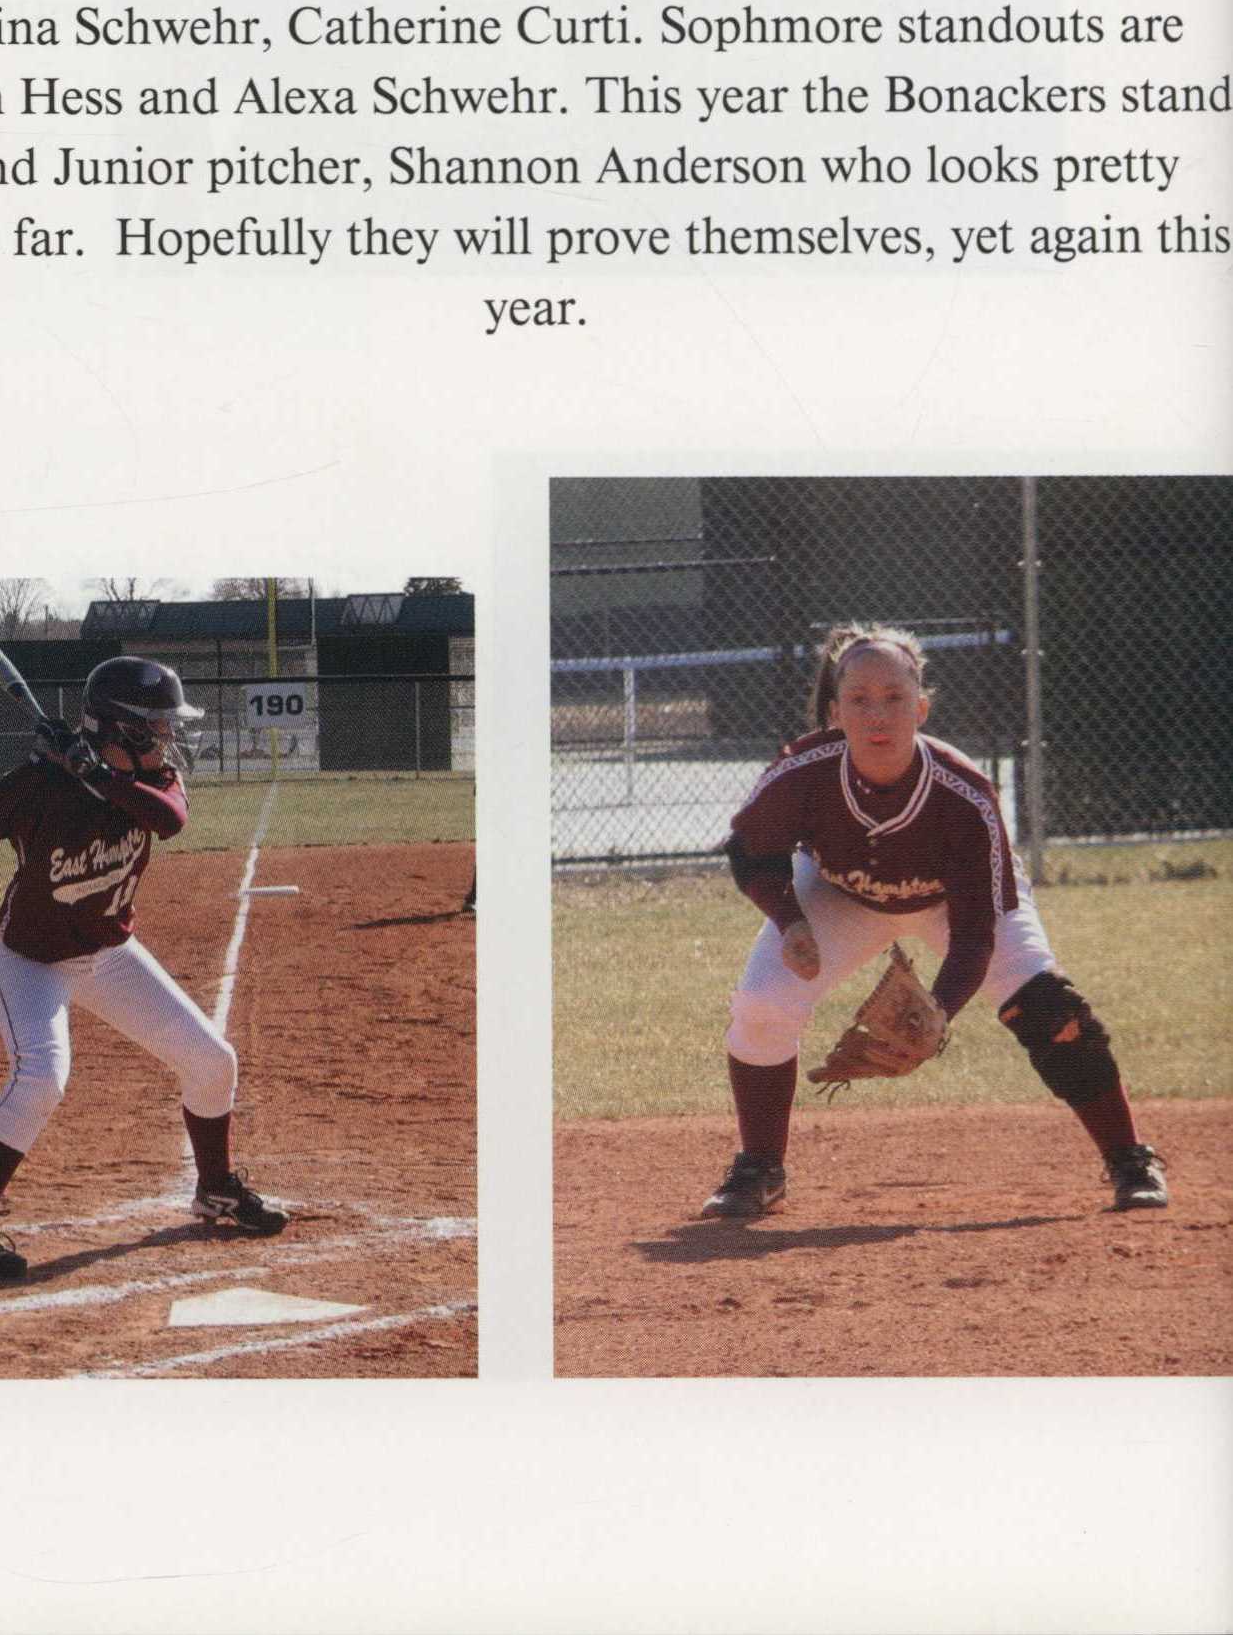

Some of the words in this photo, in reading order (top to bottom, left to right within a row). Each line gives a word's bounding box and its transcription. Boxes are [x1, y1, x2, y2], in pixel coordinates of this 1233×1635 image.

[75, 6, 272, 53] Schwehr,
[288, 5, 501, 46] Catherine
[517, 4, 642, 45] Curti.
[661, 5, 882, 53] Sophmore
[898, 4, 1104, 44] standouts
[1120, 15, 1184, 43] are
[21, 77, 123, 116] Hess
[139, 76, 219, 116] and
[233, 76, 358, 115] Alexa
[373, 76, 568, 115] Schwehr.
[585, 74, 682, 114] This
[696, 86, 789, 123] year
[802, 75, 869, 114] the
[885, 74, 1106, 114] Bonackers
[1122, 74, 1232, 113] stand
[53, 145, 194, 186] Junior
[207, 145, 372, 194] pitcher,
[390, 146, 580, 185] Shannon
[596, 145, 806, 184] Anderson
[821, 145, 911, 184] who
[927, 144, 1039, 184] looks
[1054, 149, 1180, 192] pretty
[14, 216, 84, 257] far.
[116, 216, 332, 266] Hopefully
[346, 216, 439, 265] they
[453, 215, 532, 255] will
[546, 227, 670, 264] prove
[685, 215, 935, 262] themselves,
[950, 220, 1014, 264] yet
[1030, 213, 1142, 263] again
[1157, 213, 1231, 254] this
[484, 298, 586, 335] year.
[249, 694, 304, 717] 190
